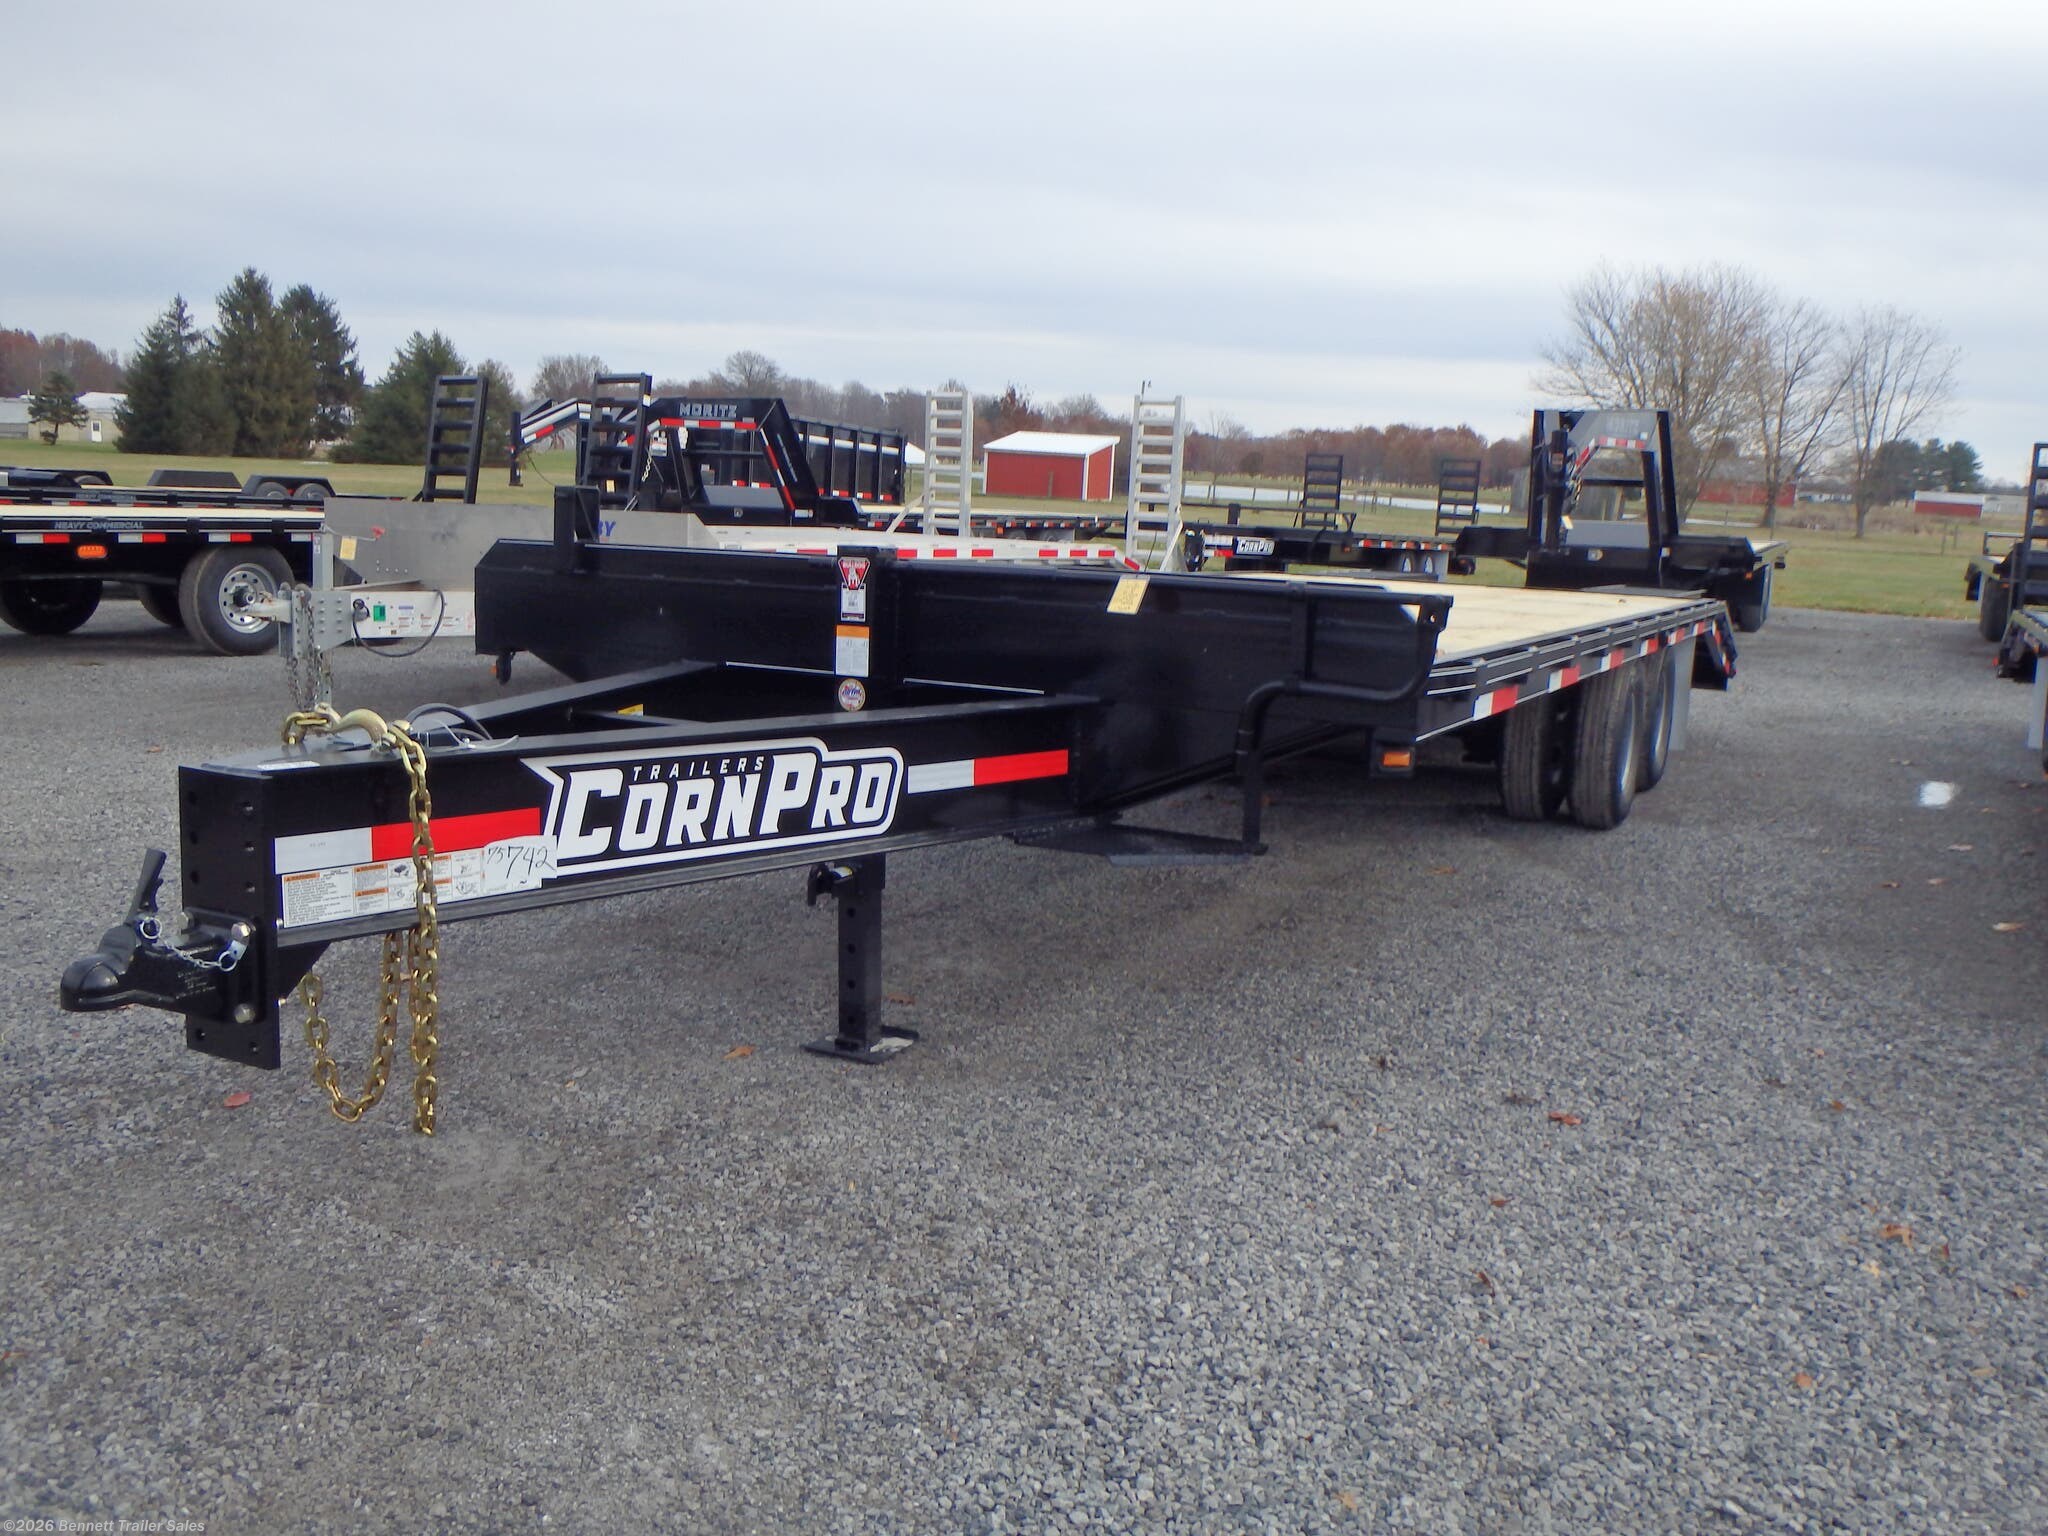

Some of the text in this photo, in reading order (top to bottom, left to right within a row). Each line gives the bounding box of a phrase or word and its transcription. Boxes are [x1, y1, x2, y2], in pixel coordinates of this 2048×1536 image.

[679, 402, 737, 417] MORITZ
[54, 521, 87, 529] HEAVY
[632, 756, 765, 782] TRAILERS
